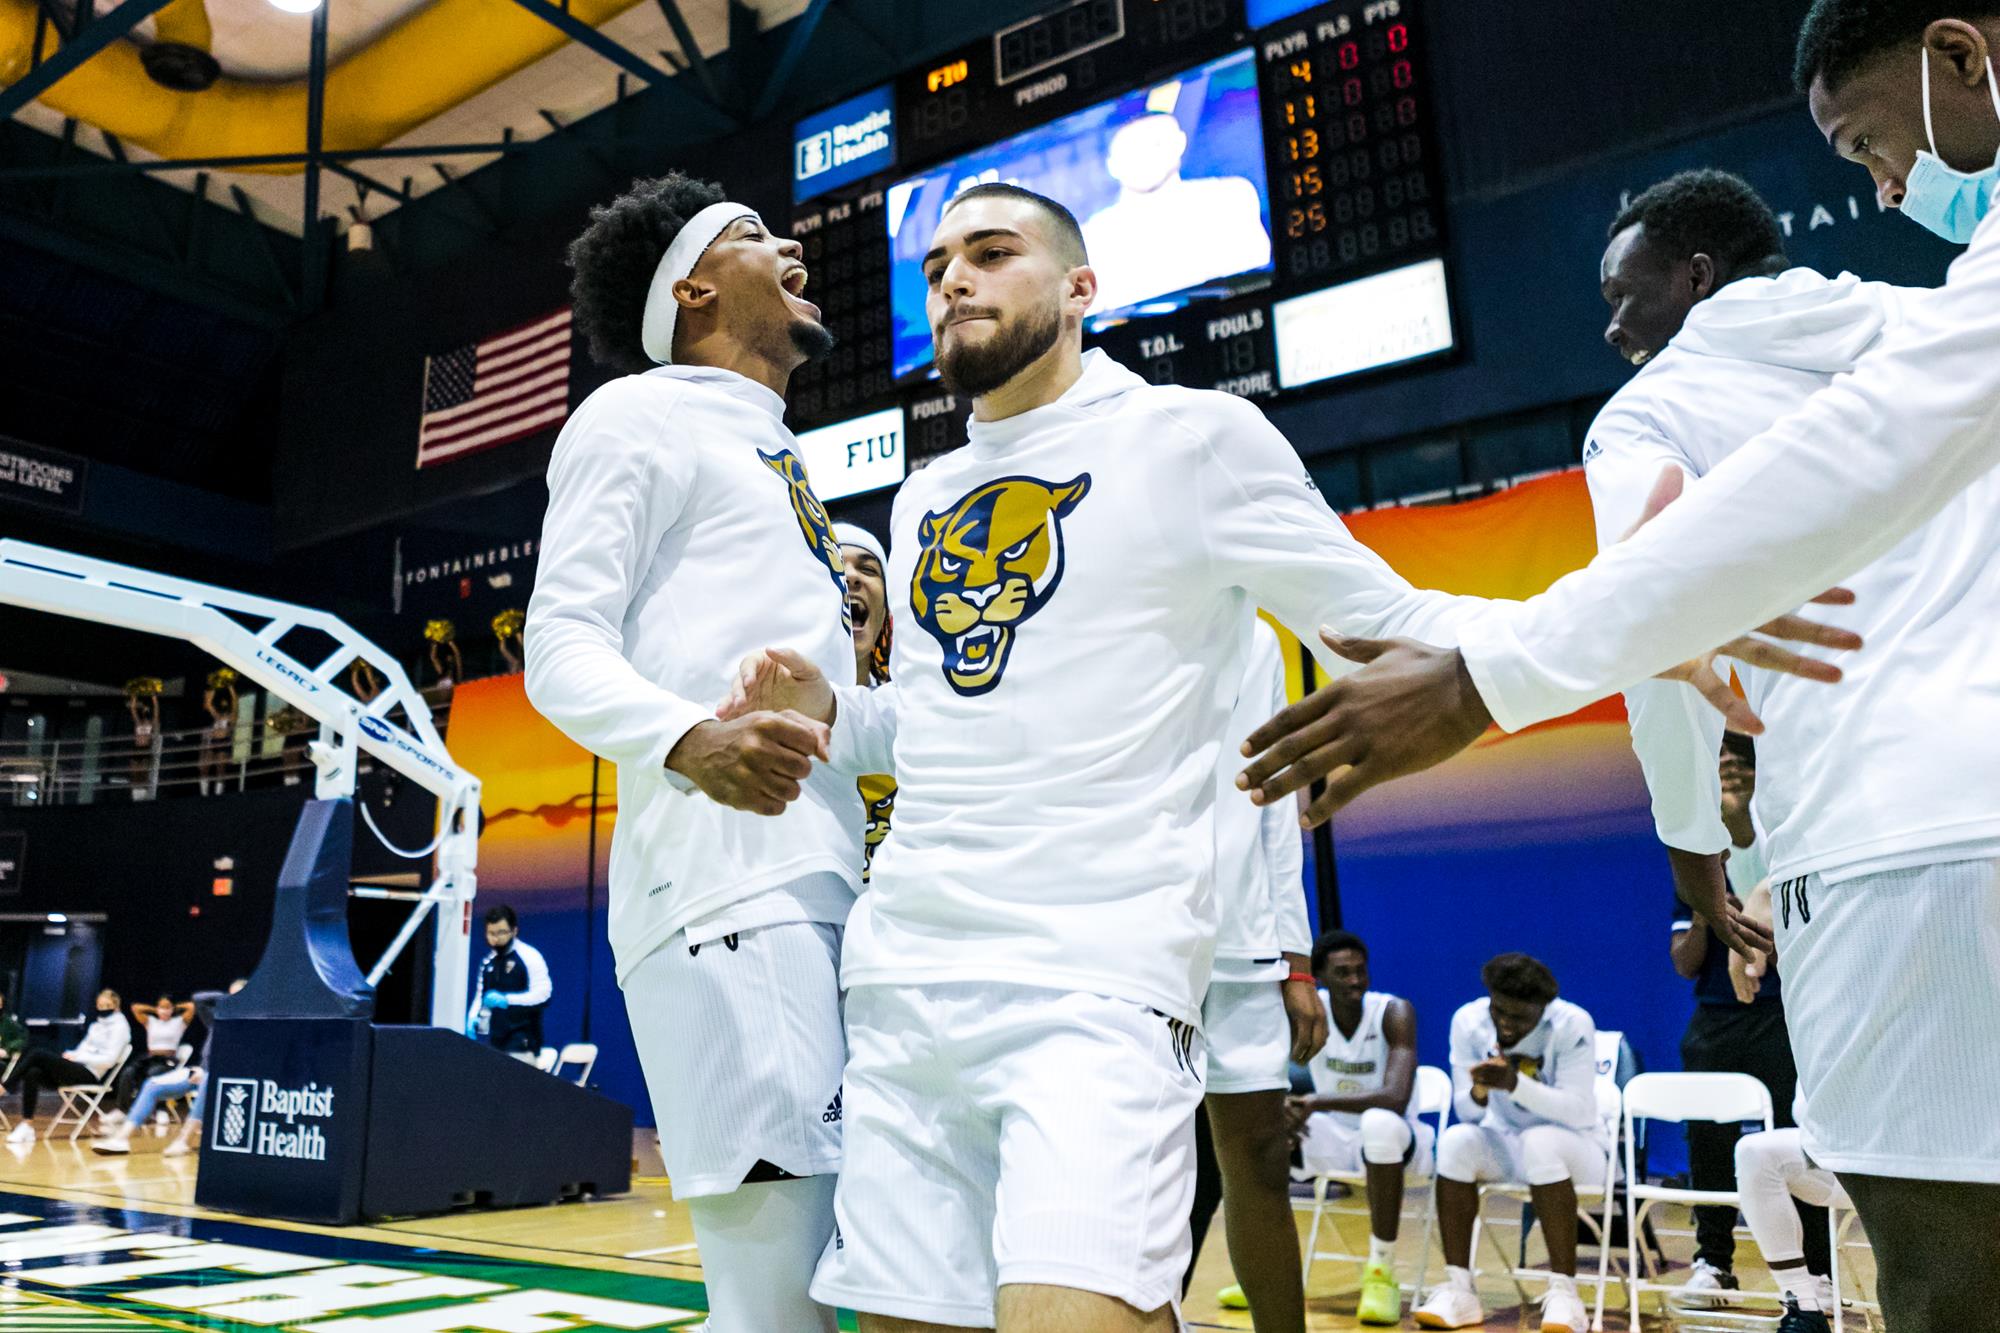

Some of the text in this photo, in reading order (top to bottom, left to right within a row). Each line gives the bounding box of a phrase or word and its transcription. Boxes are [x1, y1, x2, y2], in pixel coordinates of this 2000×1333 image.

[1264, 0, 1400, 61] PLYR FLS PTS
[1290, 23, 1408, 83] 4 0 0
[927, 59, 968, 92] FIU
[1014, 73, 1068, 107] PERIOD
[1285, 95, 1316, 125] 11
[1393, 60, 1413, 89] 0
[833, 109, 891, 146] Baptist
[1288, 128, 1319, 161] 13
[833, 130, 889, 167] Health
[1292, 165, 1323, 196] 15
[1288, 202, 1327, 238] 25
[1207, 308, 1264, 341] FOULS
[911, 395, 956, 421] FOULS
[846, 431, 897, 469] FIU
[256, 650, 320, 693] LEGACY
[397, 740, 455, 781] SPORTS
[260, 1079, 335, 1125] Baptist
[256, 1120, 326, 1161] Health
